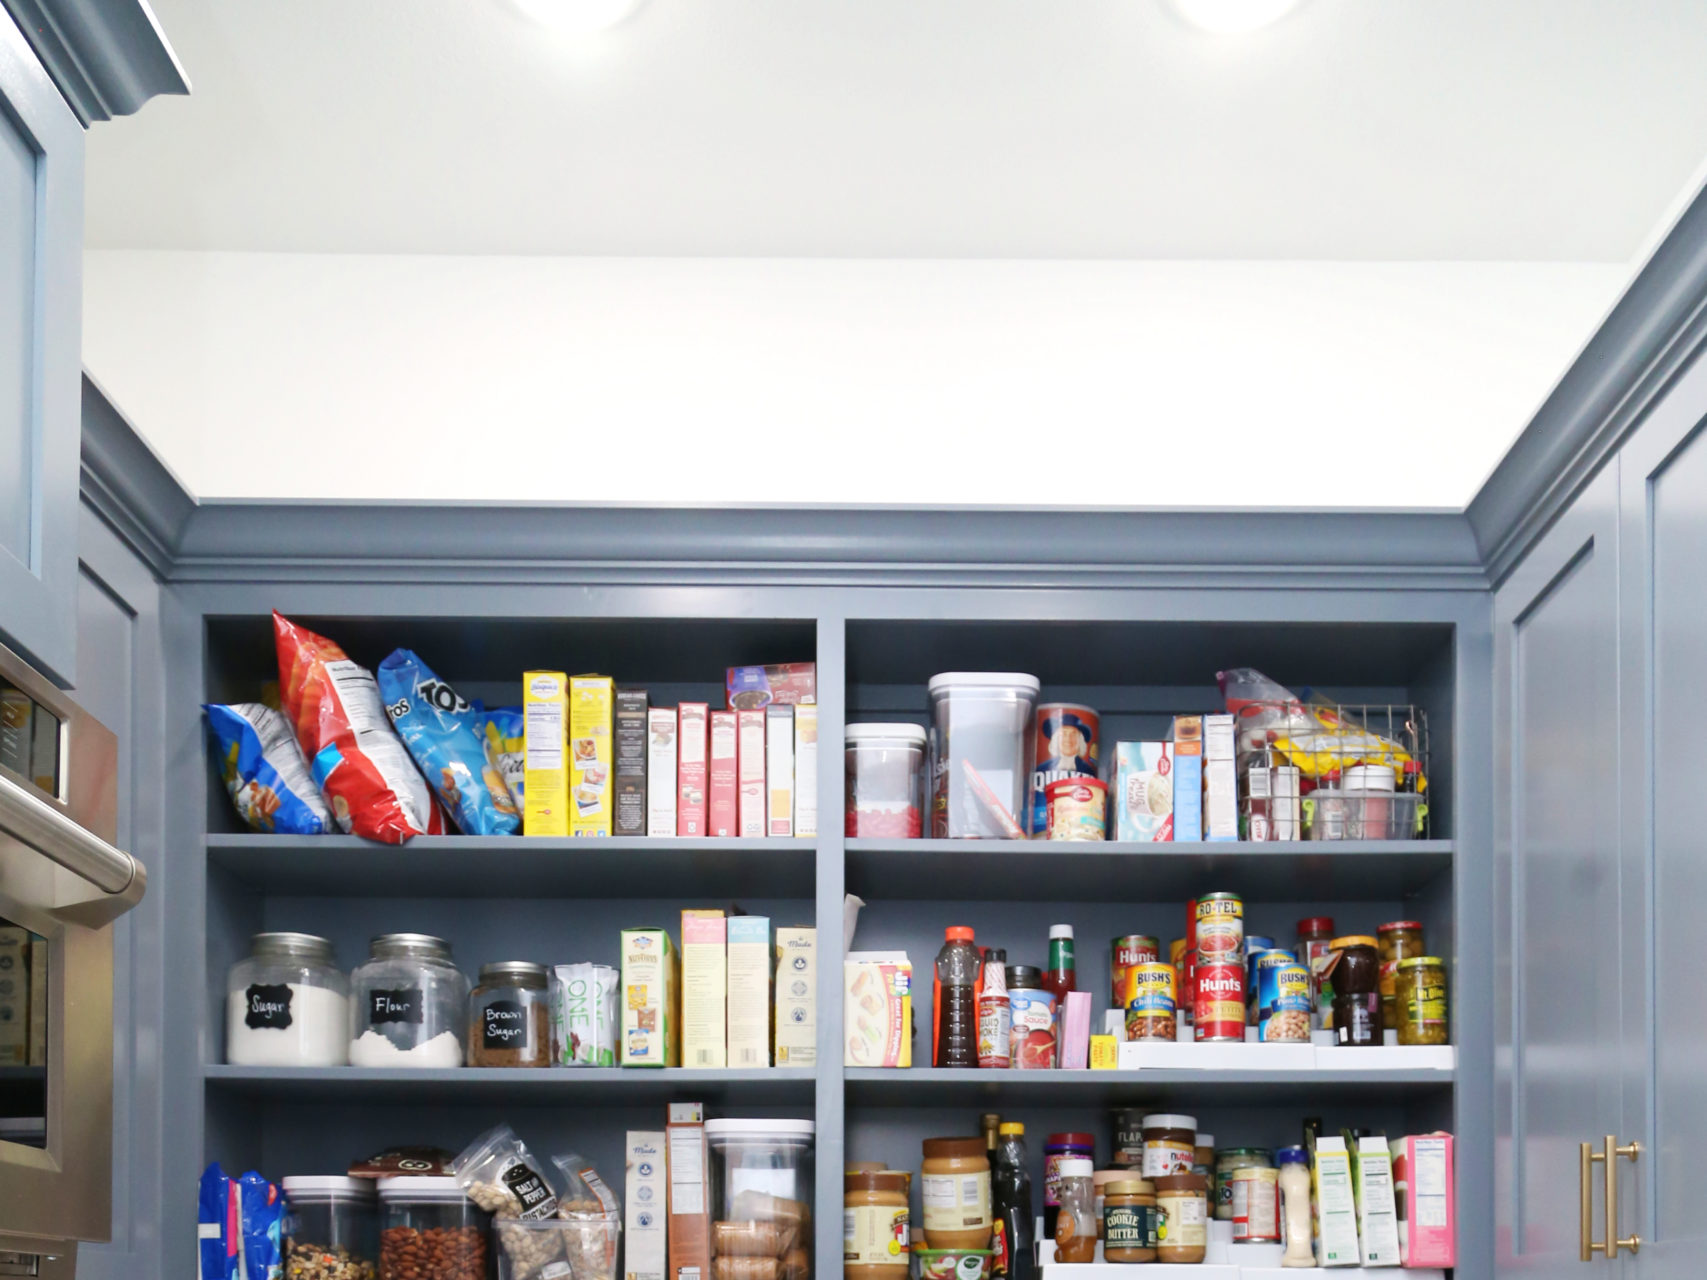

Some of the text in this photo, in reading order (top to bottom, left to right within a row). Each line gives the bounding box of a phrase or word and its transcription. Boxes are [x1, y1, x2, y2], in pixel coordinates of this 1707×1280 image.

[1137, 973, 1171, 984] BUSH'S
[252, 994, 284, 1019] Sugar
[376, 997, 411, 1013] Flour
[486, 1009, 522, 1020] Brown
[1024, 1015, 1048, 1024] Sauce
[487, 1024, 522, 1040] Sugar
[1107, 1214, 1139, 1227] COOKIE
[1108, 1228, 1139, 1239] BUTTER
